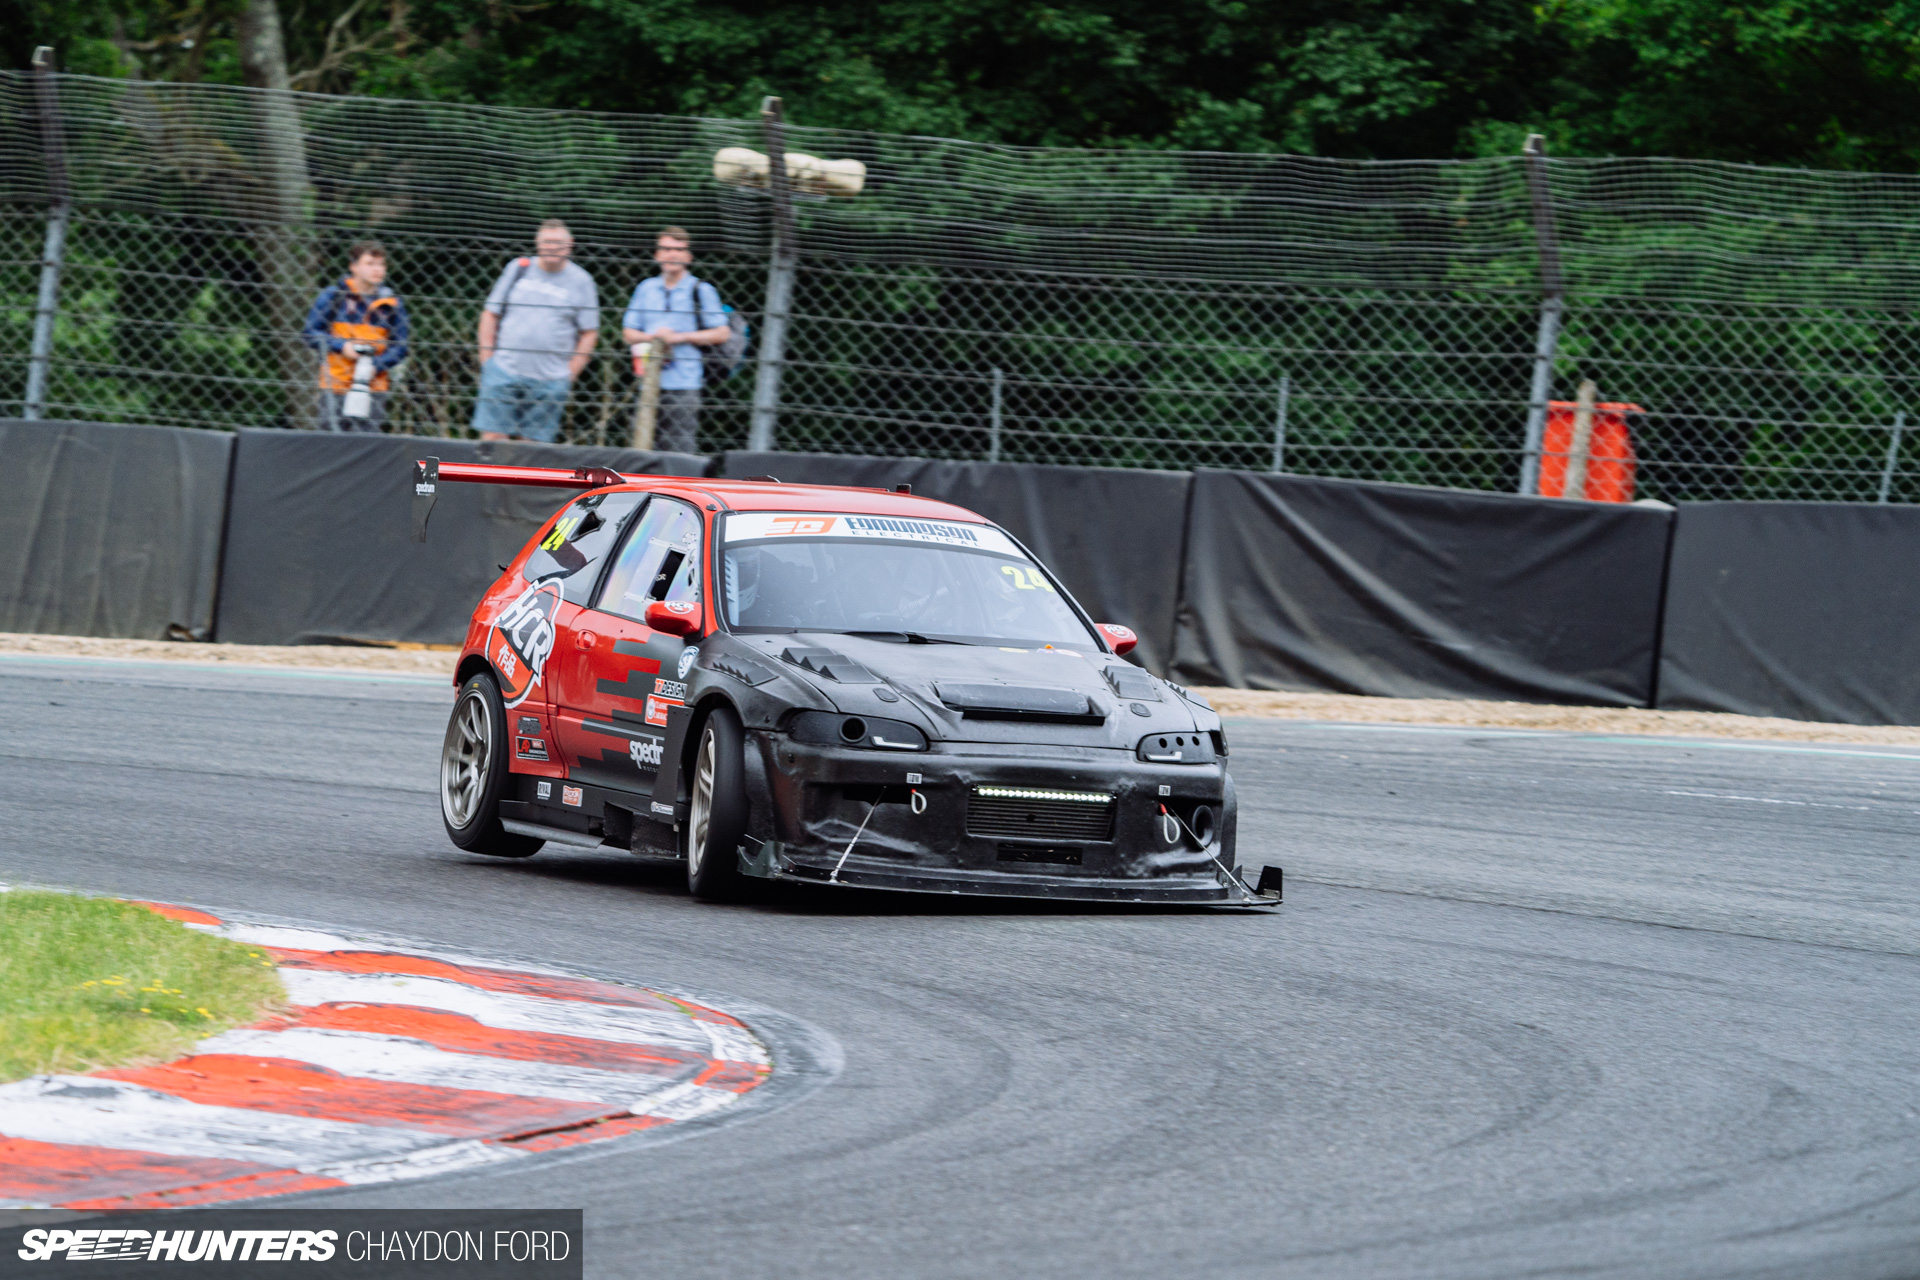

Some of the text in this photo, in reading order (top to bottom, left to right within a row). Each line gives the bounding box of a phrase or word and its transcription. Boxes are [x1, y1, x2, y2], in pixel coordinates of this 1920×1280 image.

[540, 517, 579, 551] 24
[844, 517, 979, 542] EDMUNDSON
[852, 530, 981, 548] ELECTRICAL
[1001, 565, 1056, 593] 24
[499, 584, 555, 677] HCR
